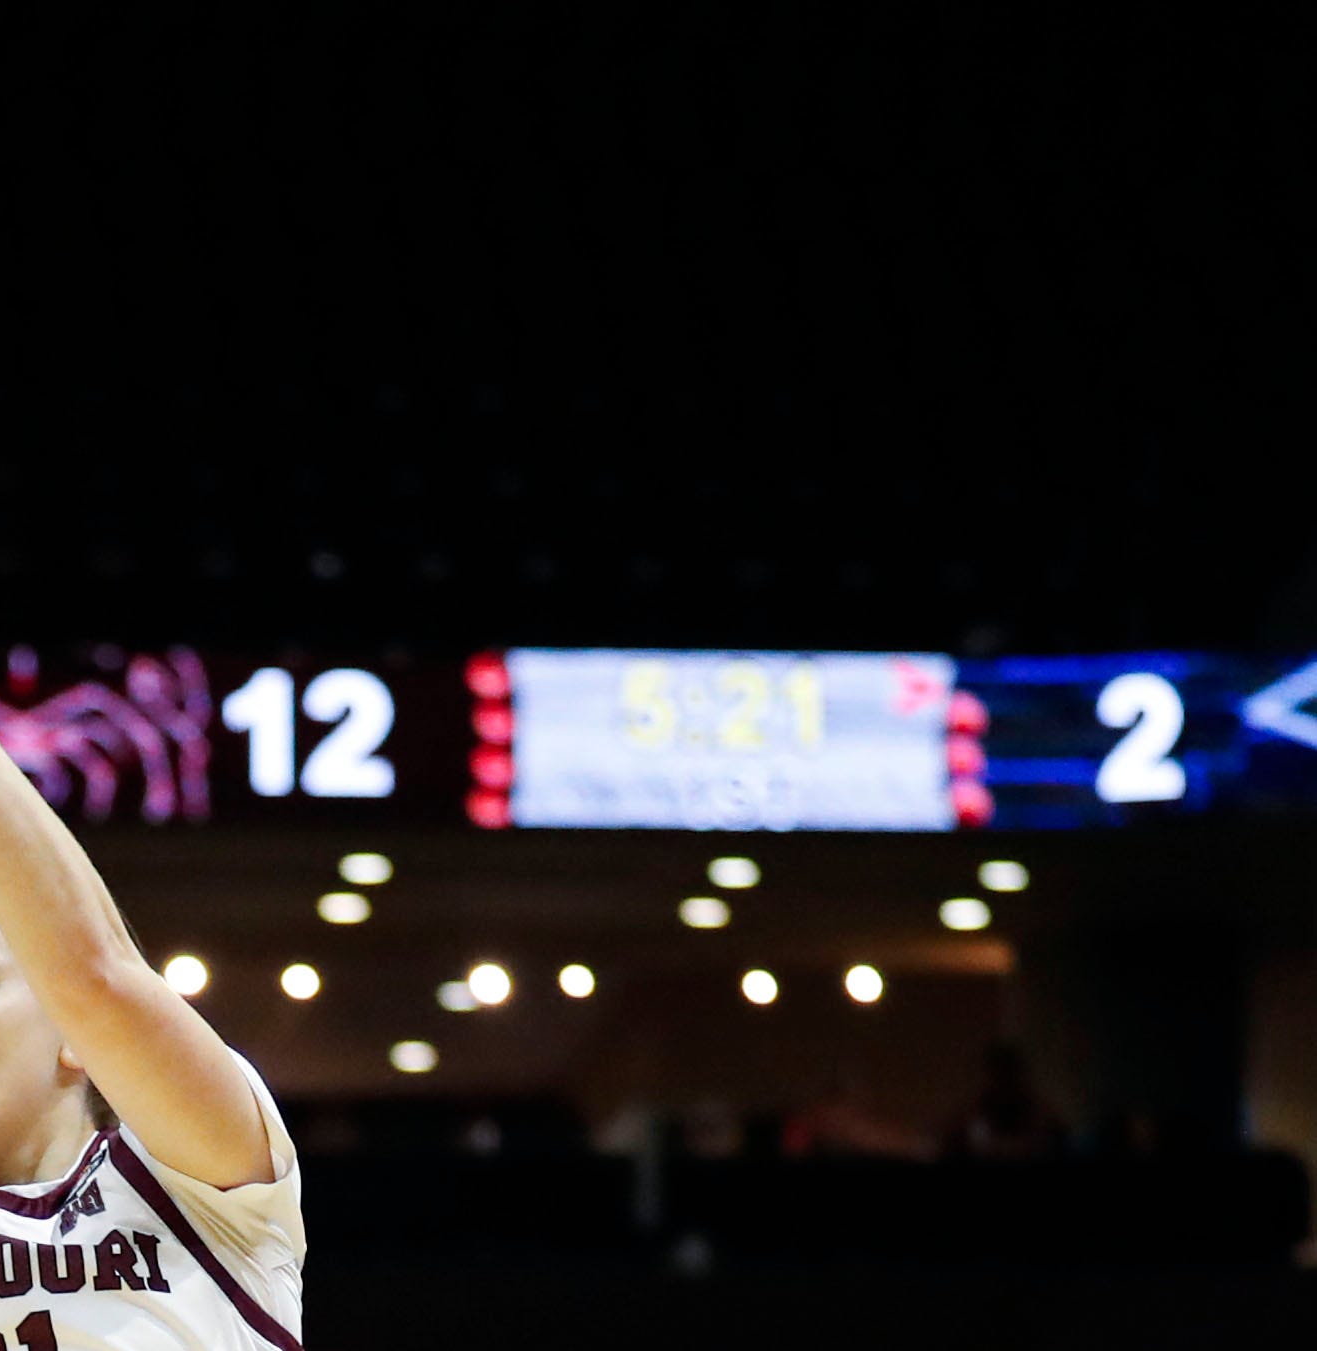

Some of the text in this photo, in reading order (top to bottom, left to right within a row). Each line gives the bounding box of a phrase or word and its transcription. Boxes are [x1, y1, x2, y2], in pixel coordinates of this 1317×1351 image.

[221, 667, 397, 797] 12
[620, 659, 826, 749] 5:21
[1095, 671, 1188, 803] 2
